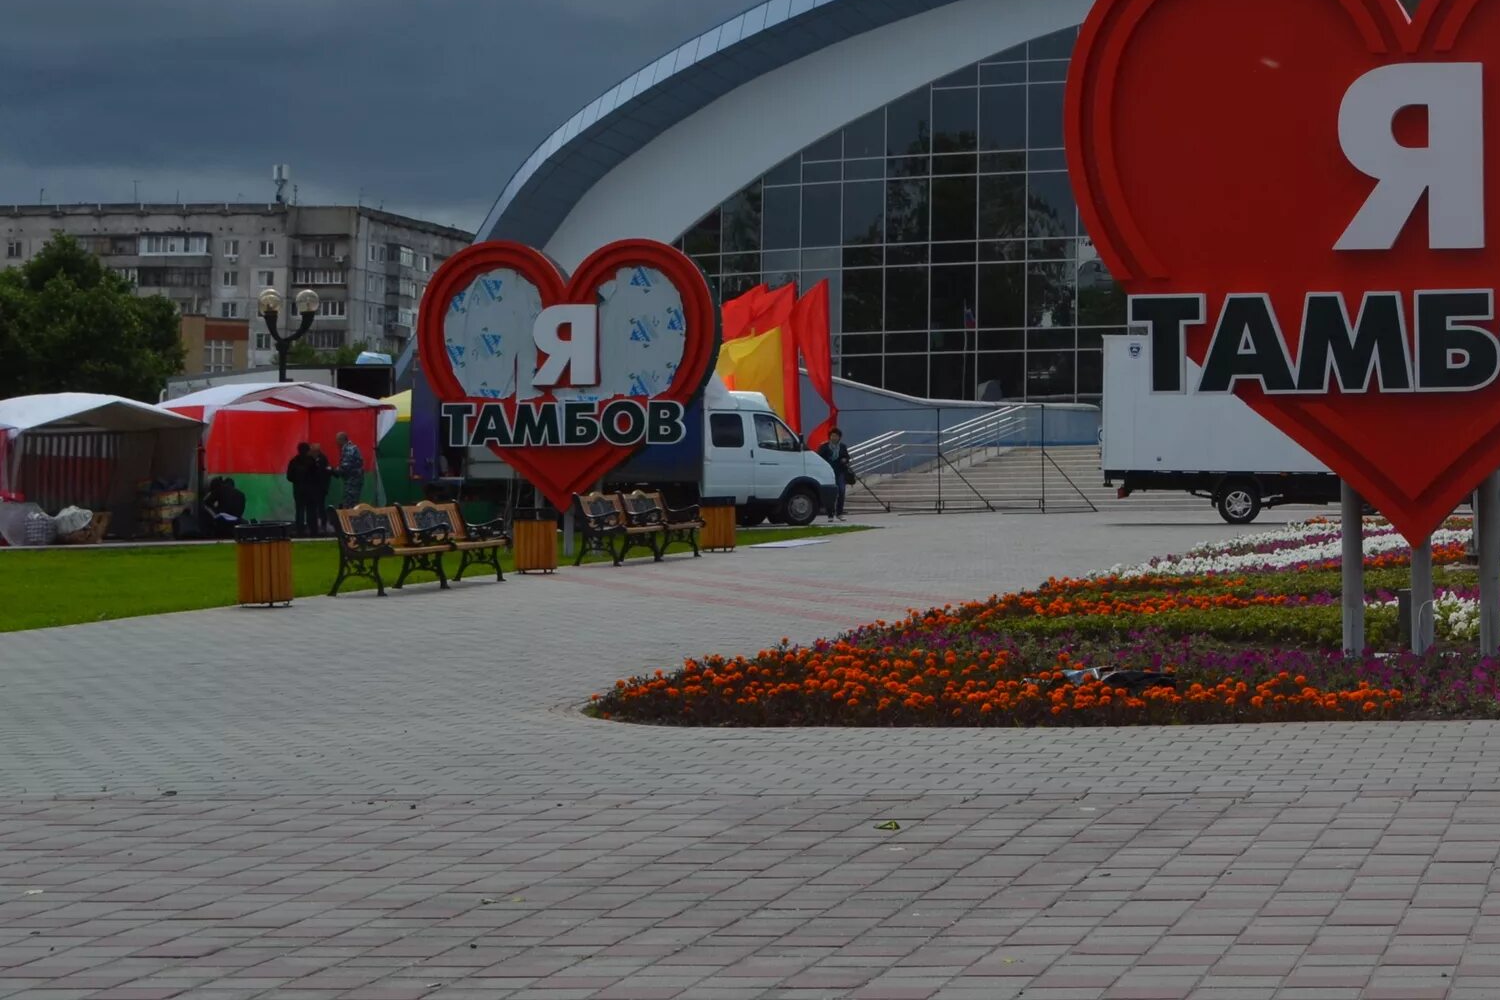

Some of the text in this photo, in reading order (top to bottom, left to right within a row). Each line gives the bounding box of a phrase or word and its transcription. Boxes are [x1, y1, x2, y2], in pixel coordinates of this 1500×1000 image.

[1333, 62, 1485, 251] Я
[532, 304, 598, 386] Я
[441, 400, 687, 447] ТАМБОВ
